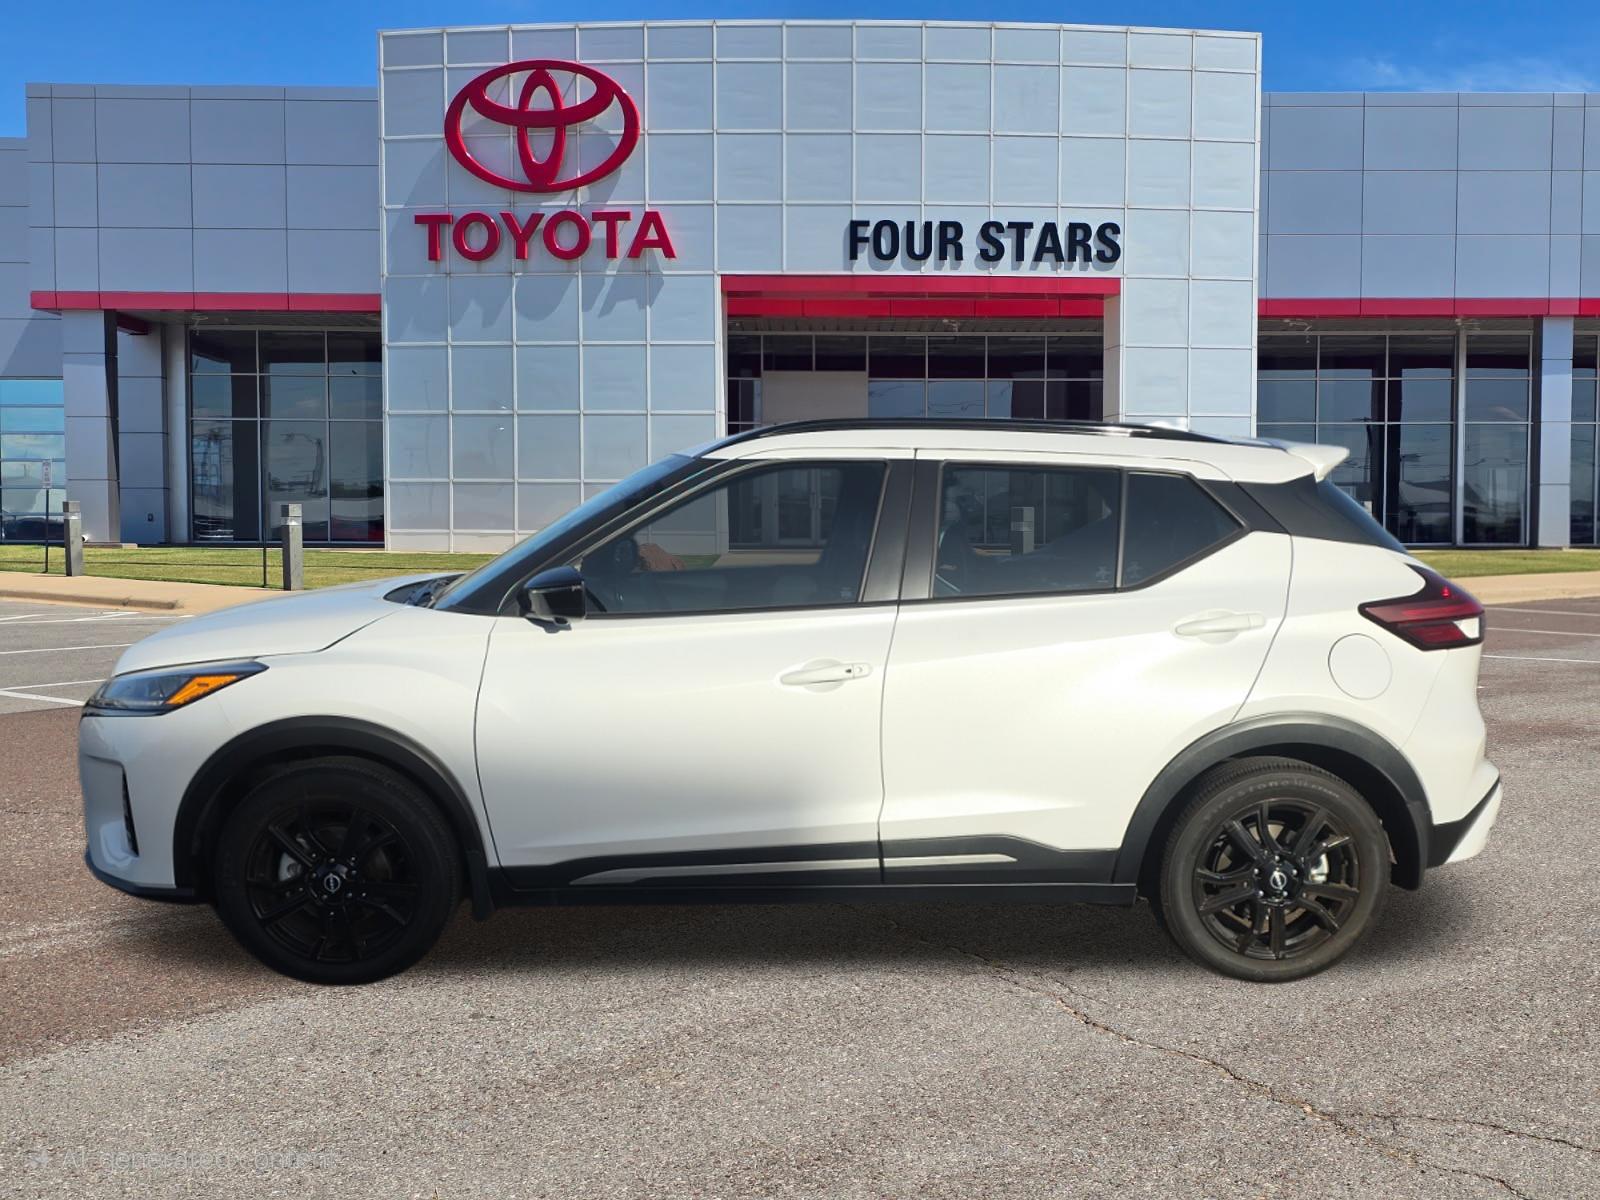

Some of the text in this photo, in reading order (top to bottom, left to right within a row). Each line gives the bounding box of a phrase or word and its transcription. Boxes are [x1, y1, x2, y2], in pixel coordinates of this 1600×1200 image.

[414, 210, 677, 262] TOYOTA
[849, 219, 1122, 263] FOUR STARS
